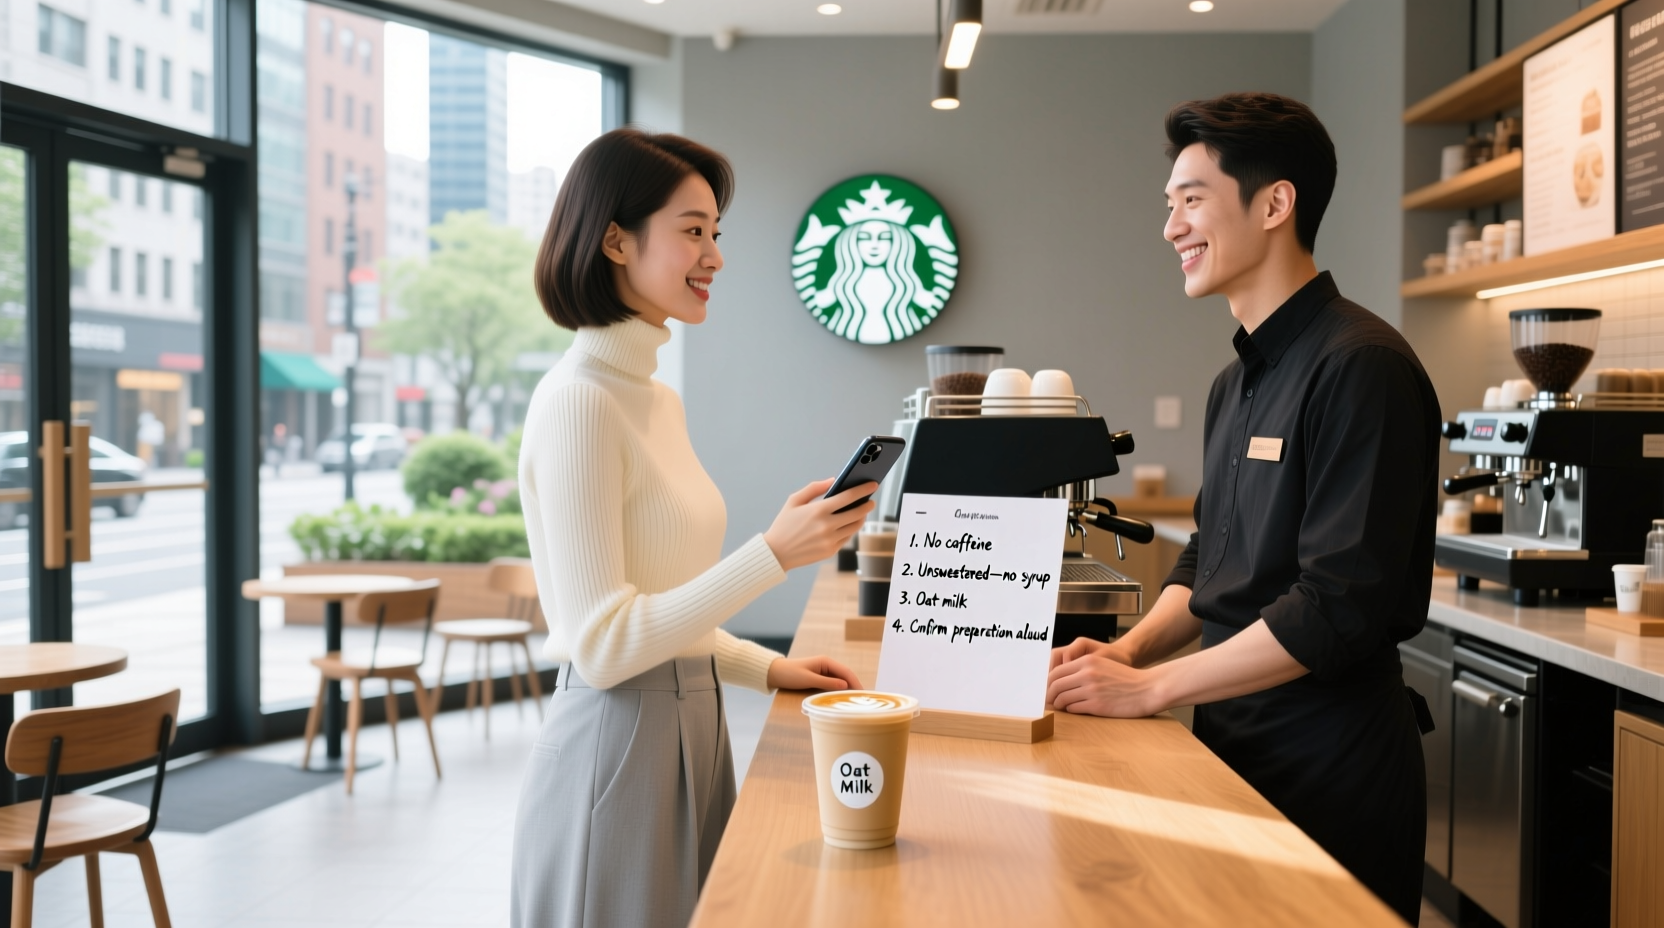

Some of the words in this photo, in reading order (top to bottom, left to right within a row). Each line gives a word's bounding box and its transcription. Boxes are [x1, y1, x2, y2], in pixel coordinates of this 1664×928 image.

[909, 533, 919, 548] 1.
[923, 531, 942, 549] No
[945, 532, 993, 553] caffeine
[901, 563, 914, 577] 2.
[1021, 571, 1051, 591] syrup
[899, 590, 911, 605] 3.
[916, 591, 940, 607] Oat
[942, 593, 968, 609] milk
[891, 618, 905, 633] 4.
[840, 762, 871, 778] Oat
[840, 779, 874, 795] Milk
